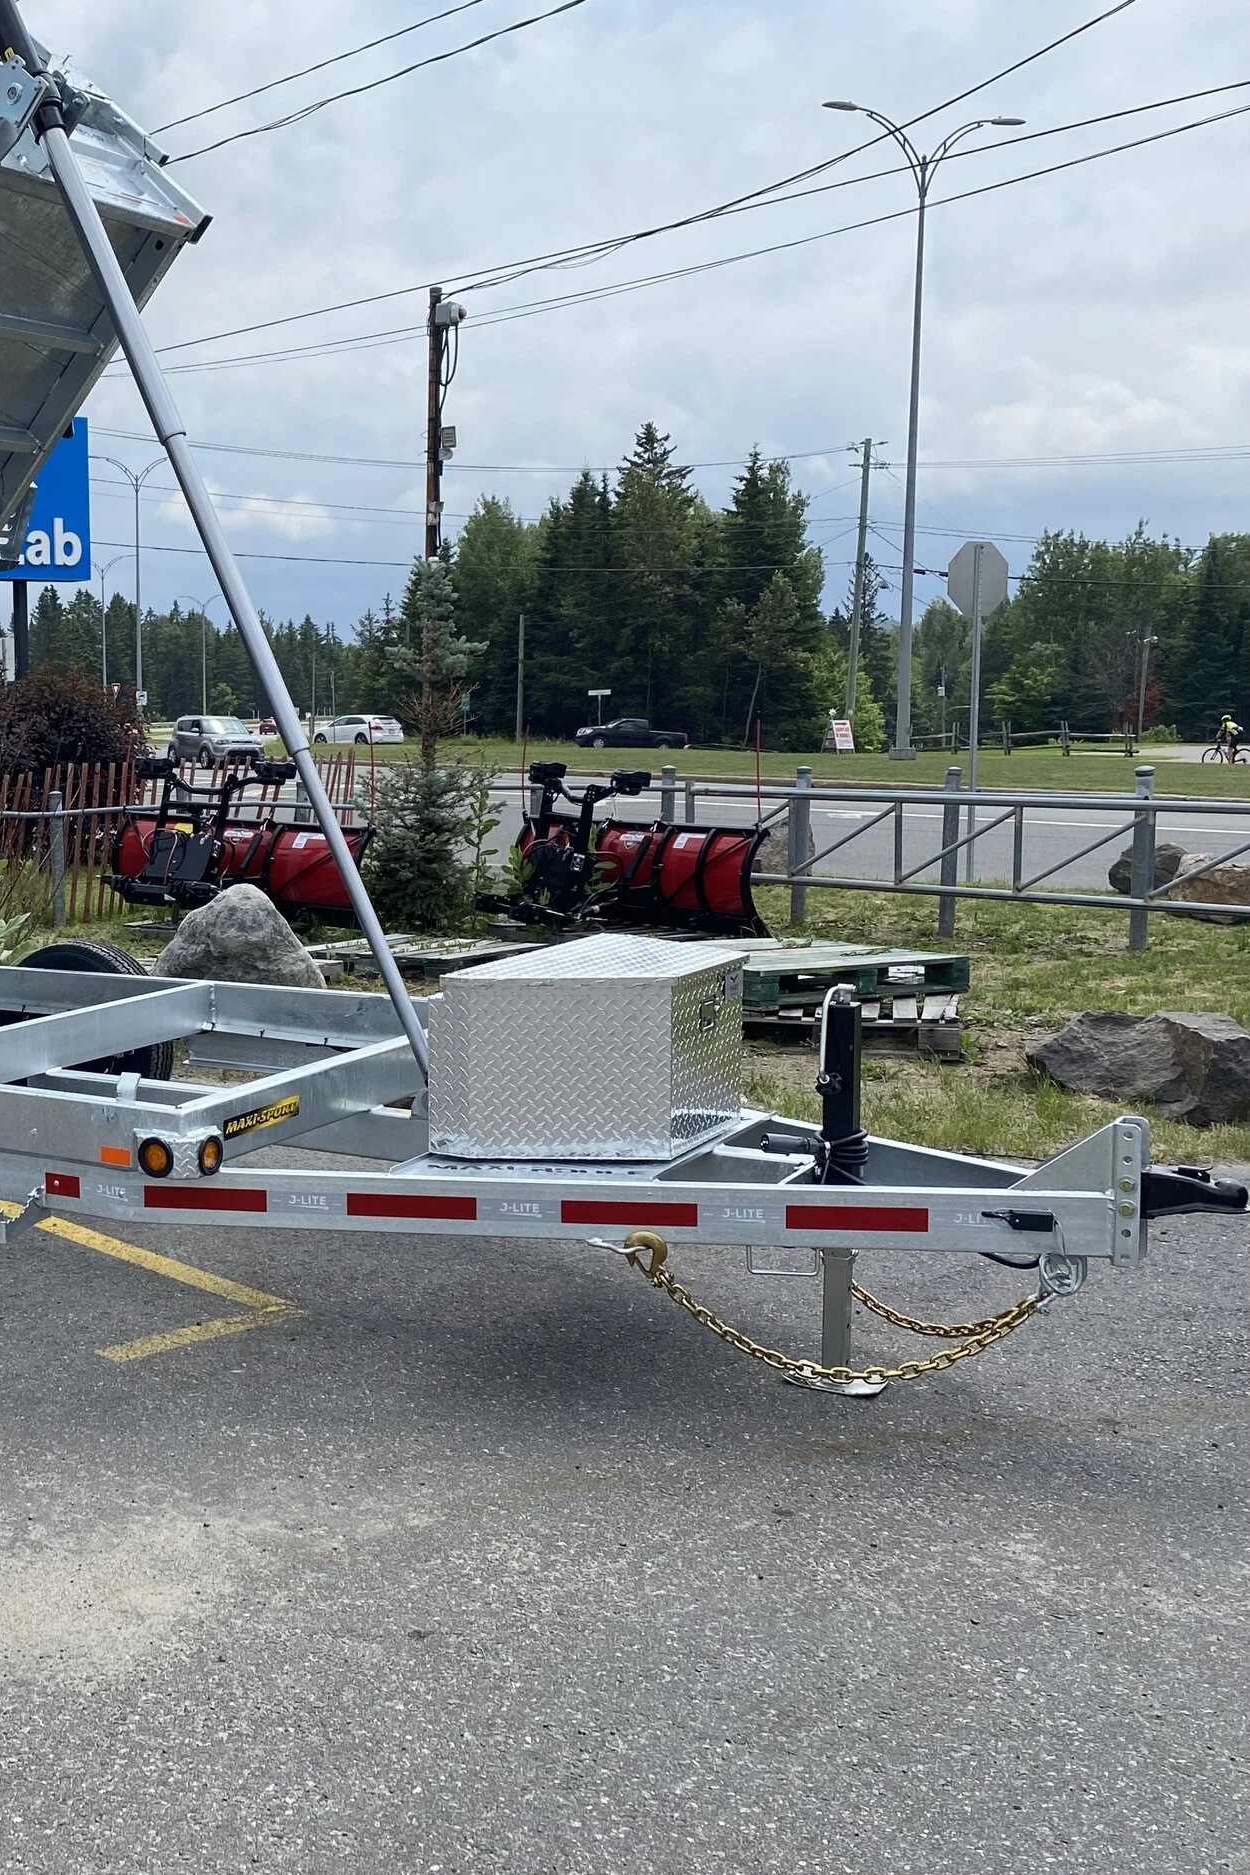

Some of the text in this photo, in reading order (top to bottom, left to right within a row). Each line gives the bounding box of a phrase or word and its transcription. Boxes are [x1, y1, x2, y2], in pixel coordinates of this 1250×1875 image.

[19, 517, 83, 566] ab
[96, 1184, 126, 1198] J-LITE
[289, 1194, 327, 1206] J-LITE
[500, 1202, 540, 1213] J-LITE
[722, 1207, 764, 1219] J-LITE
[954, 1213, 987, 1224] J-LI
